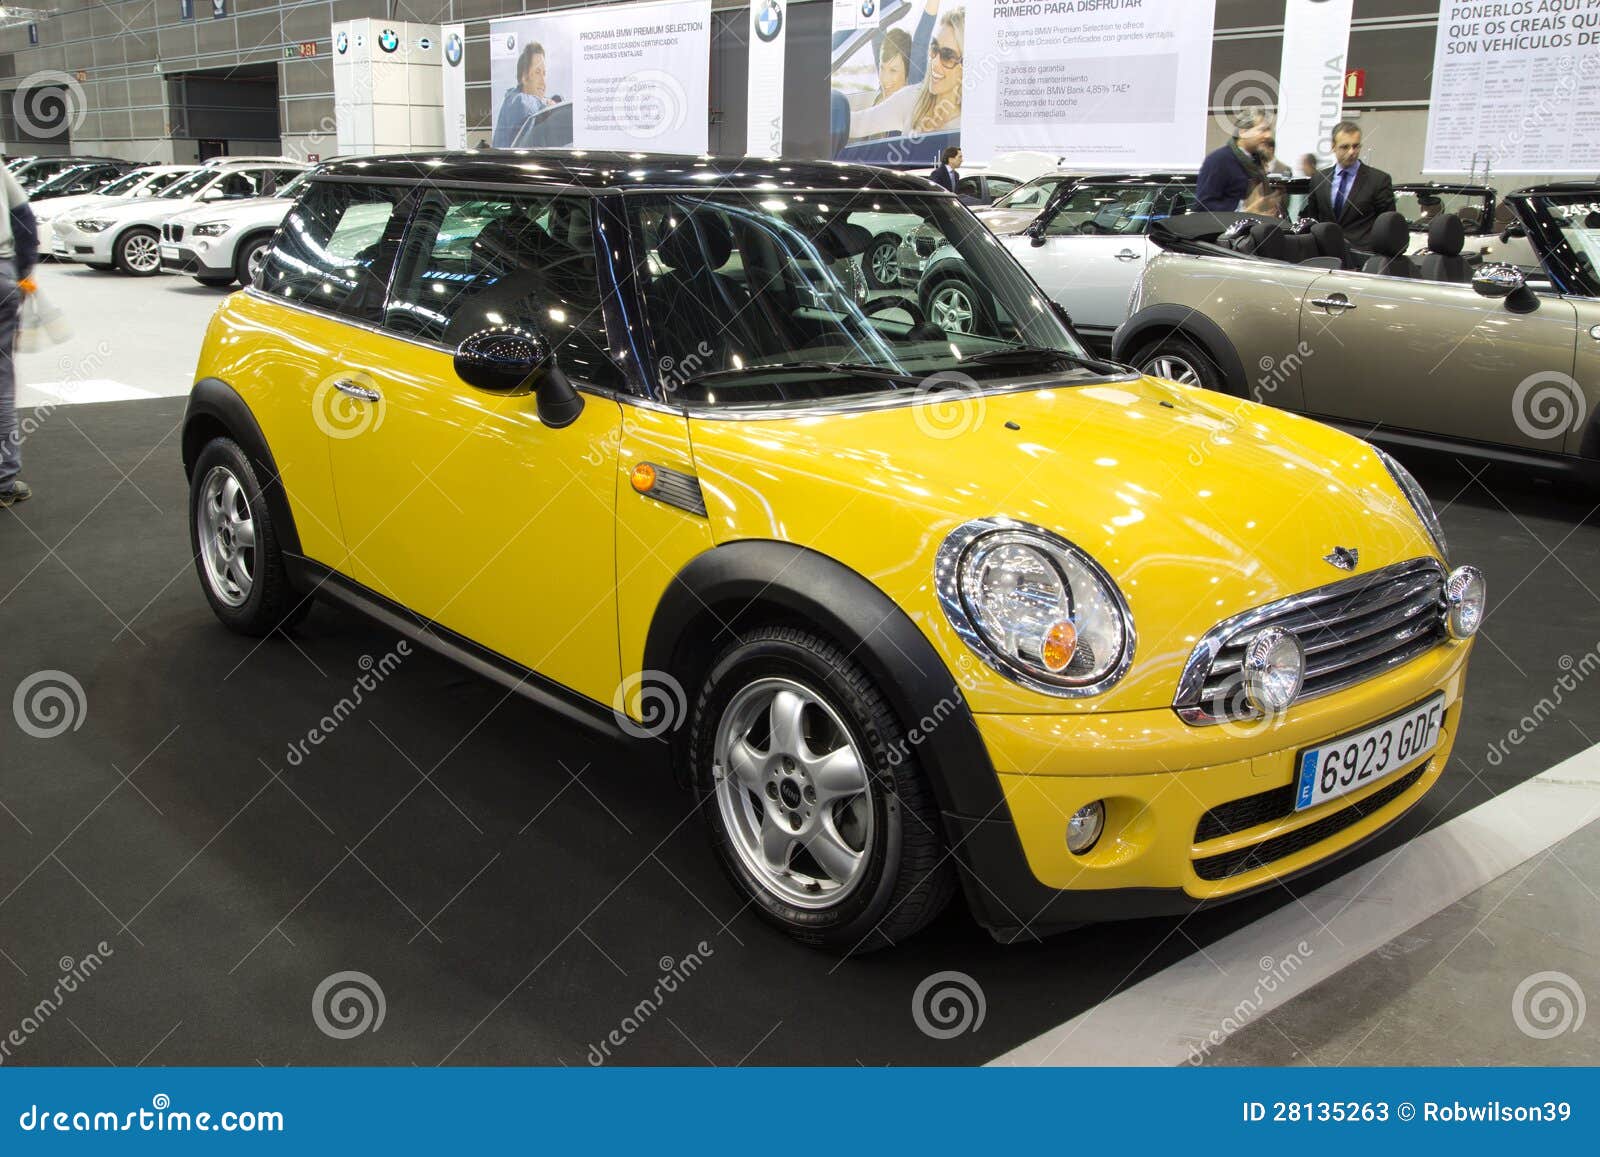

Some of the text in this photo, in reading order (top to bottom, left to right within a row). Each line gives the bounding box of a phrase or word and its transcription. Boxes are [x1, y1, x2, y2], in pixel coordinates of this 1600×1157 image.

[993, 4, 1041, 18] PRIMERO
[1044, 2, 1074, 14] PARA
[1077, 0, 1142, 12] DISFRUTAR
[1451, 1, 1532, 20] PONERLOS
[580, 22, 703, 40] PROGRAMA BMW PREMIUM SELECTION
[1034, 27, 1052, 36] BMW
[1053, 25, 1082, 34] Premium
[1082, 23, 1114, 32] Selection
[1122, 21, 1144, 30] ofrece
[1449, 12, 1600, 38] QUE OS CREAÍS QU
[1062, 34, 1100, 44] Certificados
[1102, 34, 1115, 42] con
[1116, 32, 1144, 42] grandes
[1448, 32, 1600, 54] SON VEHÍCULOS DE
[1037, 76, 1088, 84] mantenimiento
[1046, 86, 1066, 95] BMW
[1067, 86, 1084, 94] Bank
[1004, 99, 1037, 108] Recompra
[1057, 98, 1078, 106] coche
[1316, 54, 1344, 168] OTURIA
[1320, 704, 1440, 794] 6923 GDF
[1302, 785, 1310, 798] E
